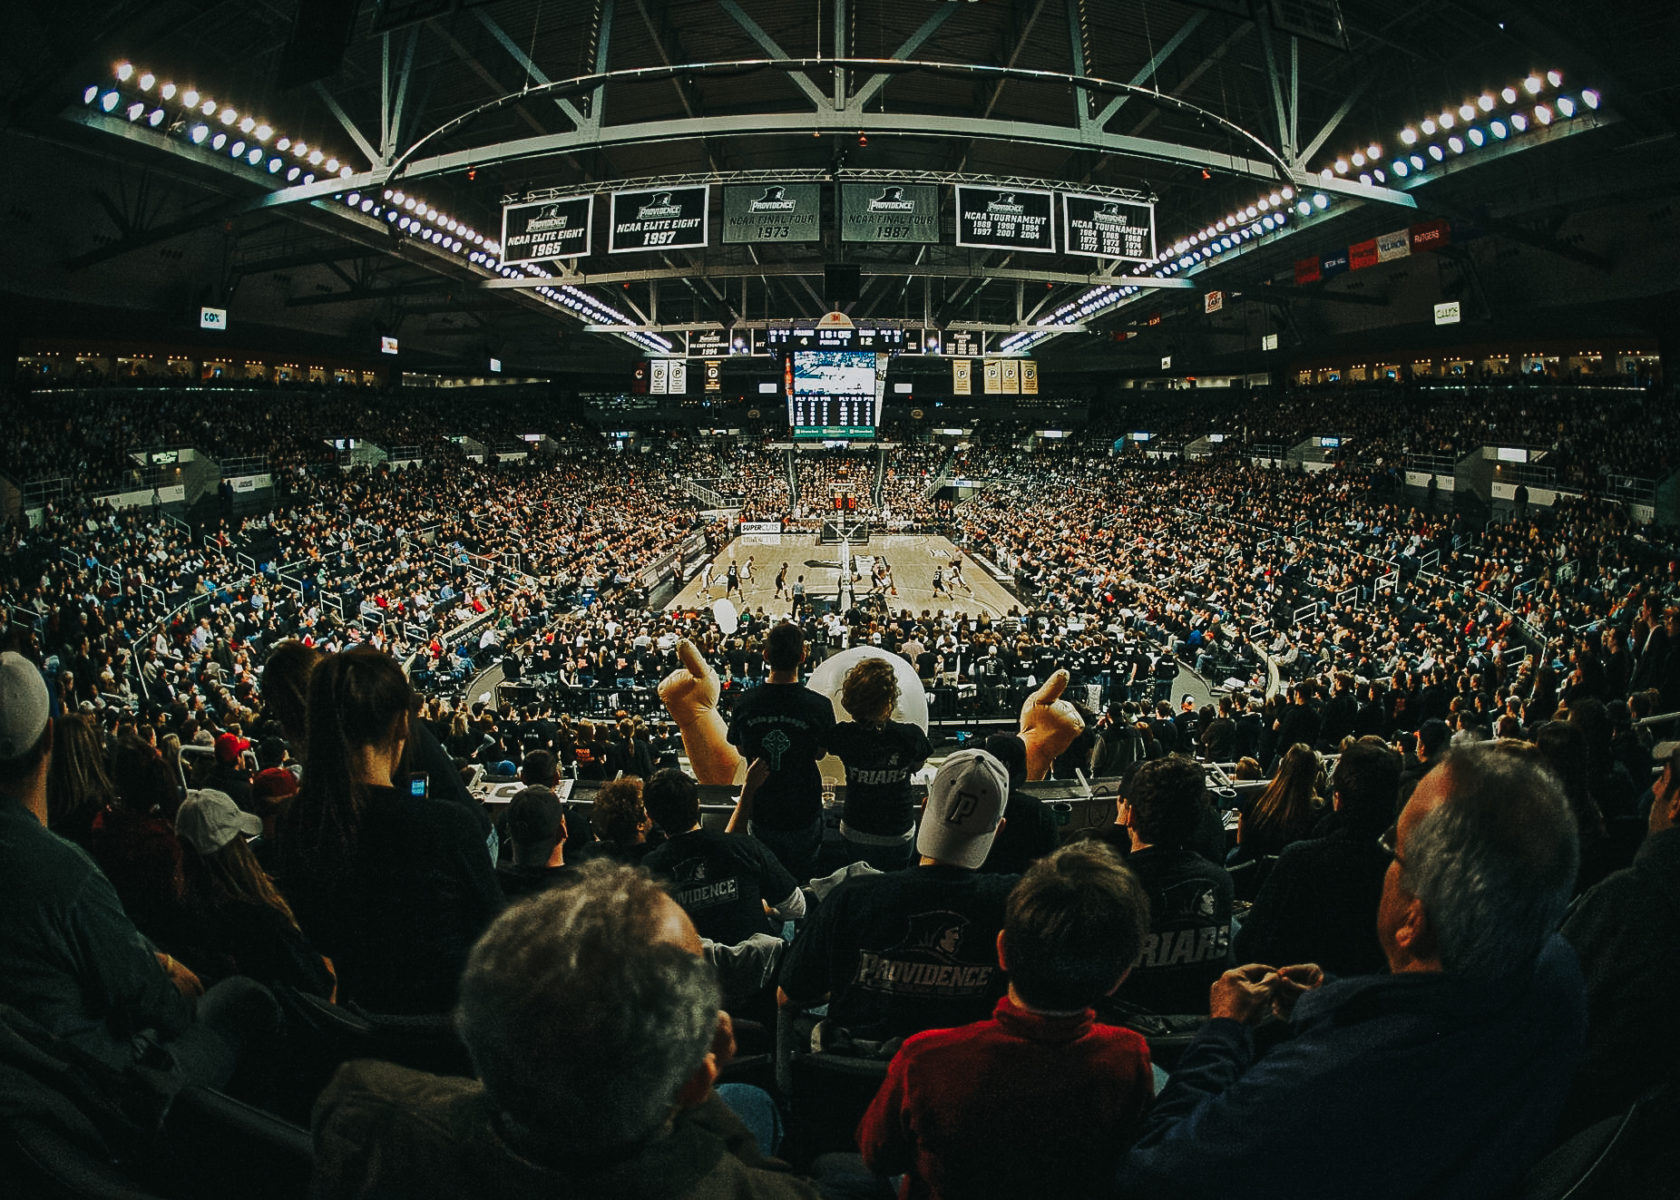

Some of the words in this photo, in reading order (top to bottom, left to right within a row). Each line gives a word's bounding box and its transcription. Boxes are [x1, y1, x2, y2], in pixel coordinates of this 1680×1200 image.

[638, 206, 681, 218] PROVIDENCE
[752, 201, 794, 211] PROVIDENCE
[871, 201, 913, 211] PROVIDENCE
[730, 216, 754, 225] NCAA
[758, 215, 786, 224] FINAL
[789, 214, 814, 223] FOUR
[849, 215, 874, 224] NCAA
[877, 215, 905, 224] FINAL
[908, 215, 933, 224] FOUR
[965, 211, 987, 220] NCAA
[989, 213, 1047, 225] TOURNAMENT
[617, 222, 641, 233] NCAA
[643, 220, 670, 231] ELITE
[672, 218, 701, 229] EIGHT
[758, 226, 789, 238] 1973
[877, 226, 910, 238] 1987
[1072, 220, 1093, 228] NCAA
[1095, 223, 1149, 236] TOURNAMENT
[508, 235, 530, 246] NCAA
[531, 231, 557, 243] ELITE
[558, 228, 584, 239] EIGHT
[643, 231, 676, 245] 1997
[1020, 231, 1040, 239] 2004
[1414, 229, 1440, 243] RUTGERS
[531, 242, 562, 257] 1965
[204, 312, 220, 322] COX
[860, 337, 873, 346] 12
[742, 524, 779, 532] SUPERCUTS
[851, 768, 908, 785] FRIARS
[945, 791, 979, 824] P
[1131, 925, 1230, 967] RIARS
[858, 952, 993, 987] PROVIDENCE
